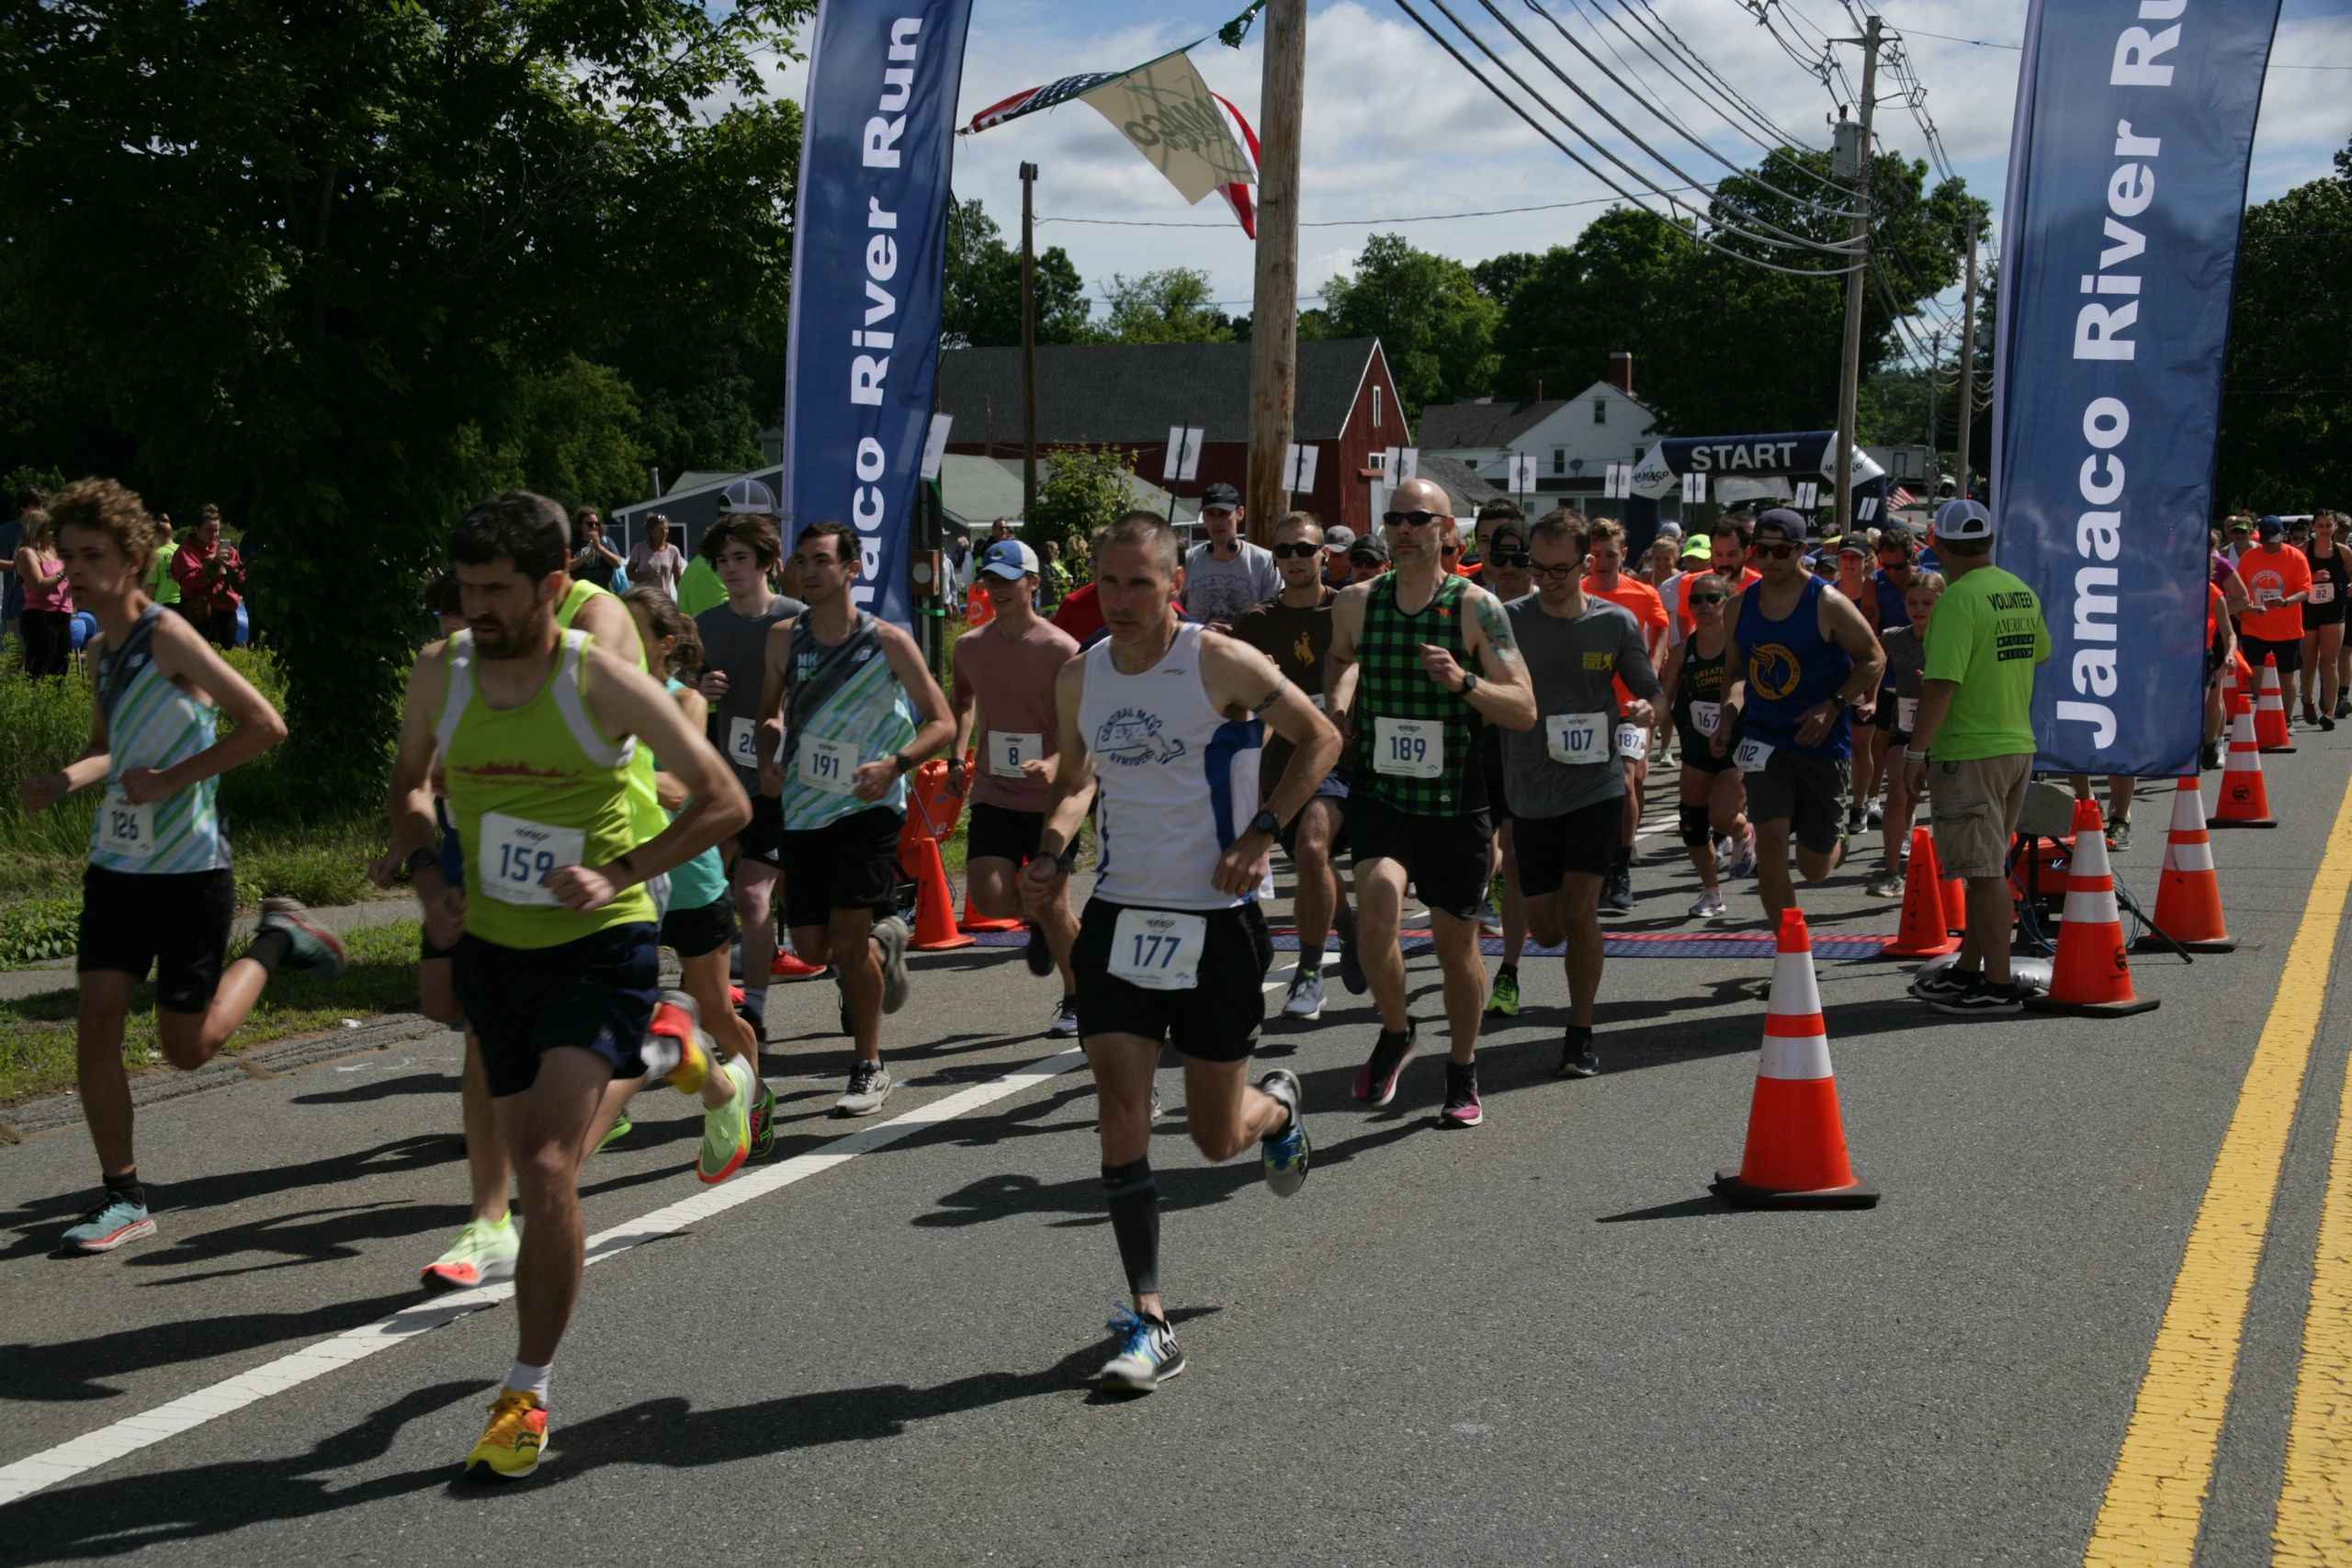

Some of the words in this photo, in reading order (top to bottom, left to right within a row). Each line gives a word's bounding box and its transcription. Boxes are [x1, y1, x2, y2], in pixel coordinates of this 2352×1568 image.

[862, 17, 922, 168] Run
[2074, 118, 2161, 361] River
[851, 195, 899, 406] River
[1690, 442, 1798, 471] START
[1632, 470, 1668, 482] JAMACO
[2056, 397, 2130, 750] Jamaco
[1986, 592, 2033, 611] VOLUNTEER
[2315, 589, 2332, 599] 82
[1995, 617, 2036, 634] AMERICAN
[1694, 667, 1724, 680] GREATE
[1698, 712, 1721, 729] 167
[1390, 736, 1426, 762] 189
[1562, 728, 1594, 751] 107
[1618, 733, 1640, 749] 187
[812, 752, 840, 779] 191
[1009, 747, 1019, 765] 8
[1738, 745, 1758, 762] 112
[111, 810, 139, 840] 126
[500, 842, 555, 885] 159
[1909, 863, 1923, 931] TIMING
[1134, 934, 1182, 968] 177
